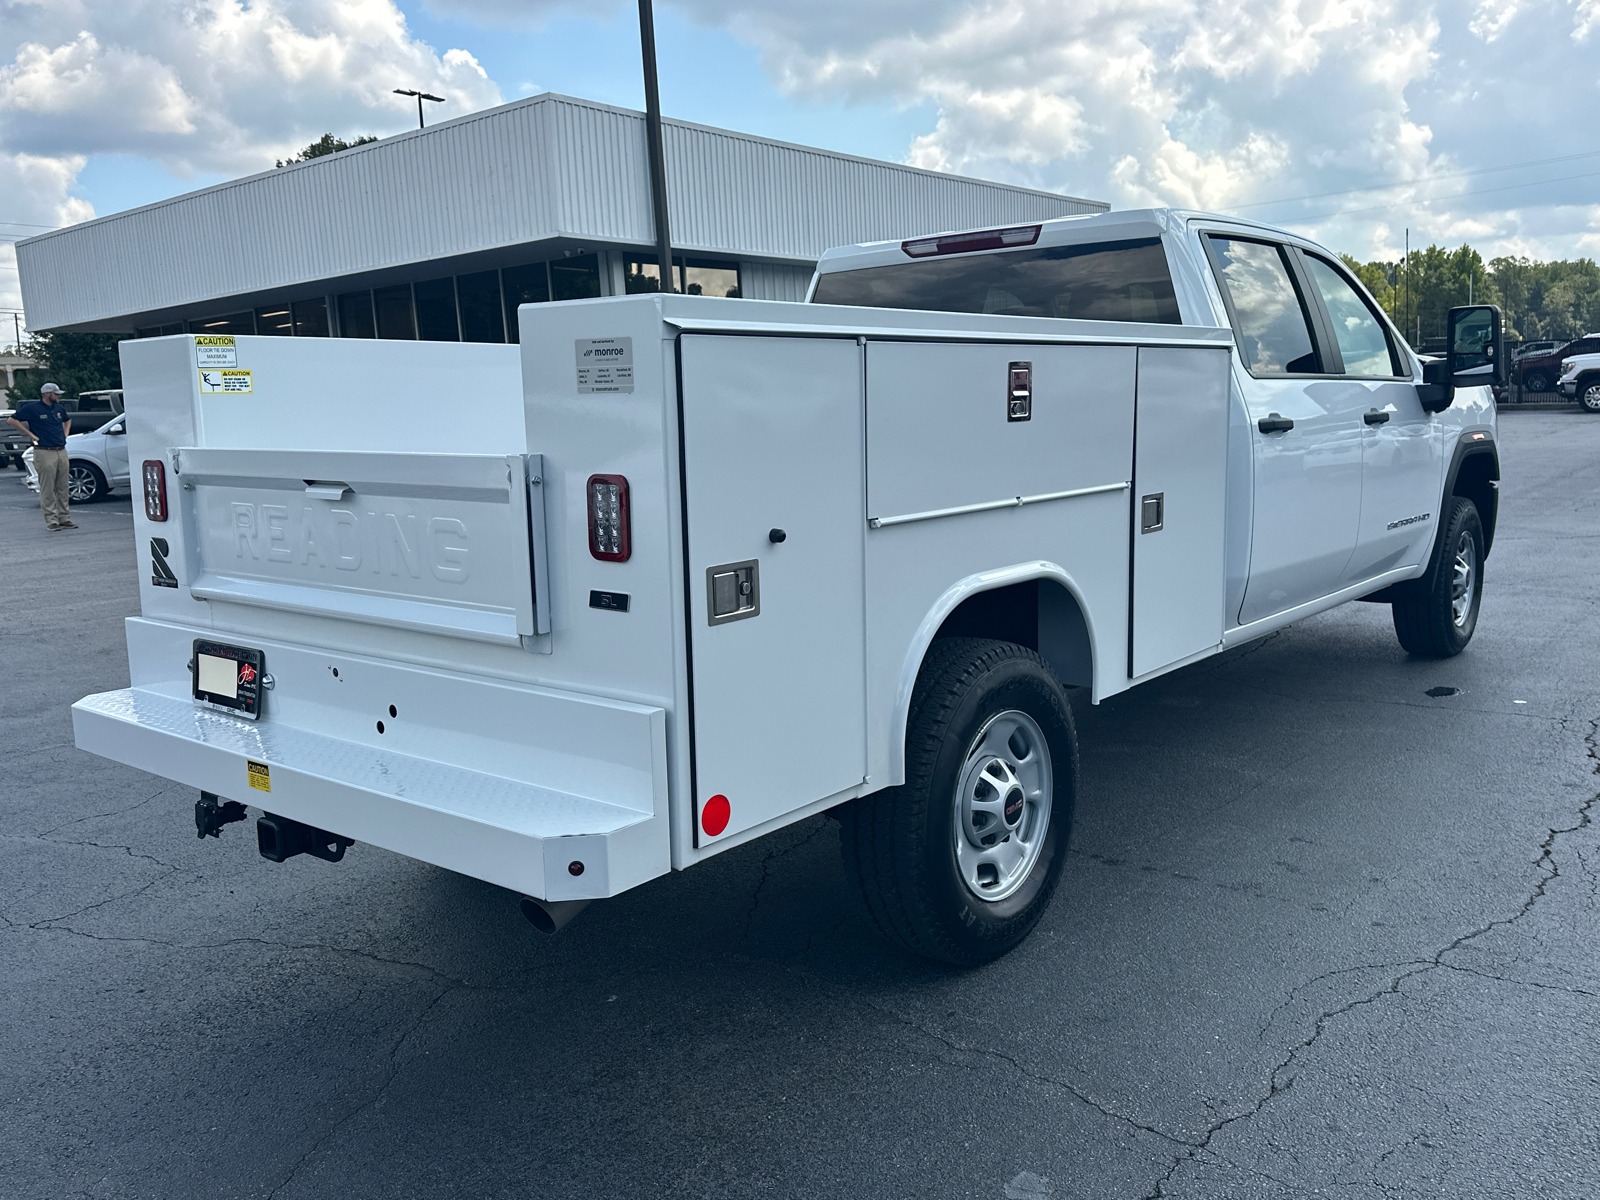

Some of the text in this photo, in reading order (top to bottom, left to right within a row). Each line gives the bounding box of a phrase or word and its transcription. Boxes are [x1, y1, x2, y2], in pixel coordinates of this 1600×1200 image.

[594, 347, 624, 356] monroe
[231, 501, 470, 584] READING
[249, 763, 269, 775] CAUTION
[1006, 798, 1022, 815] GMC
